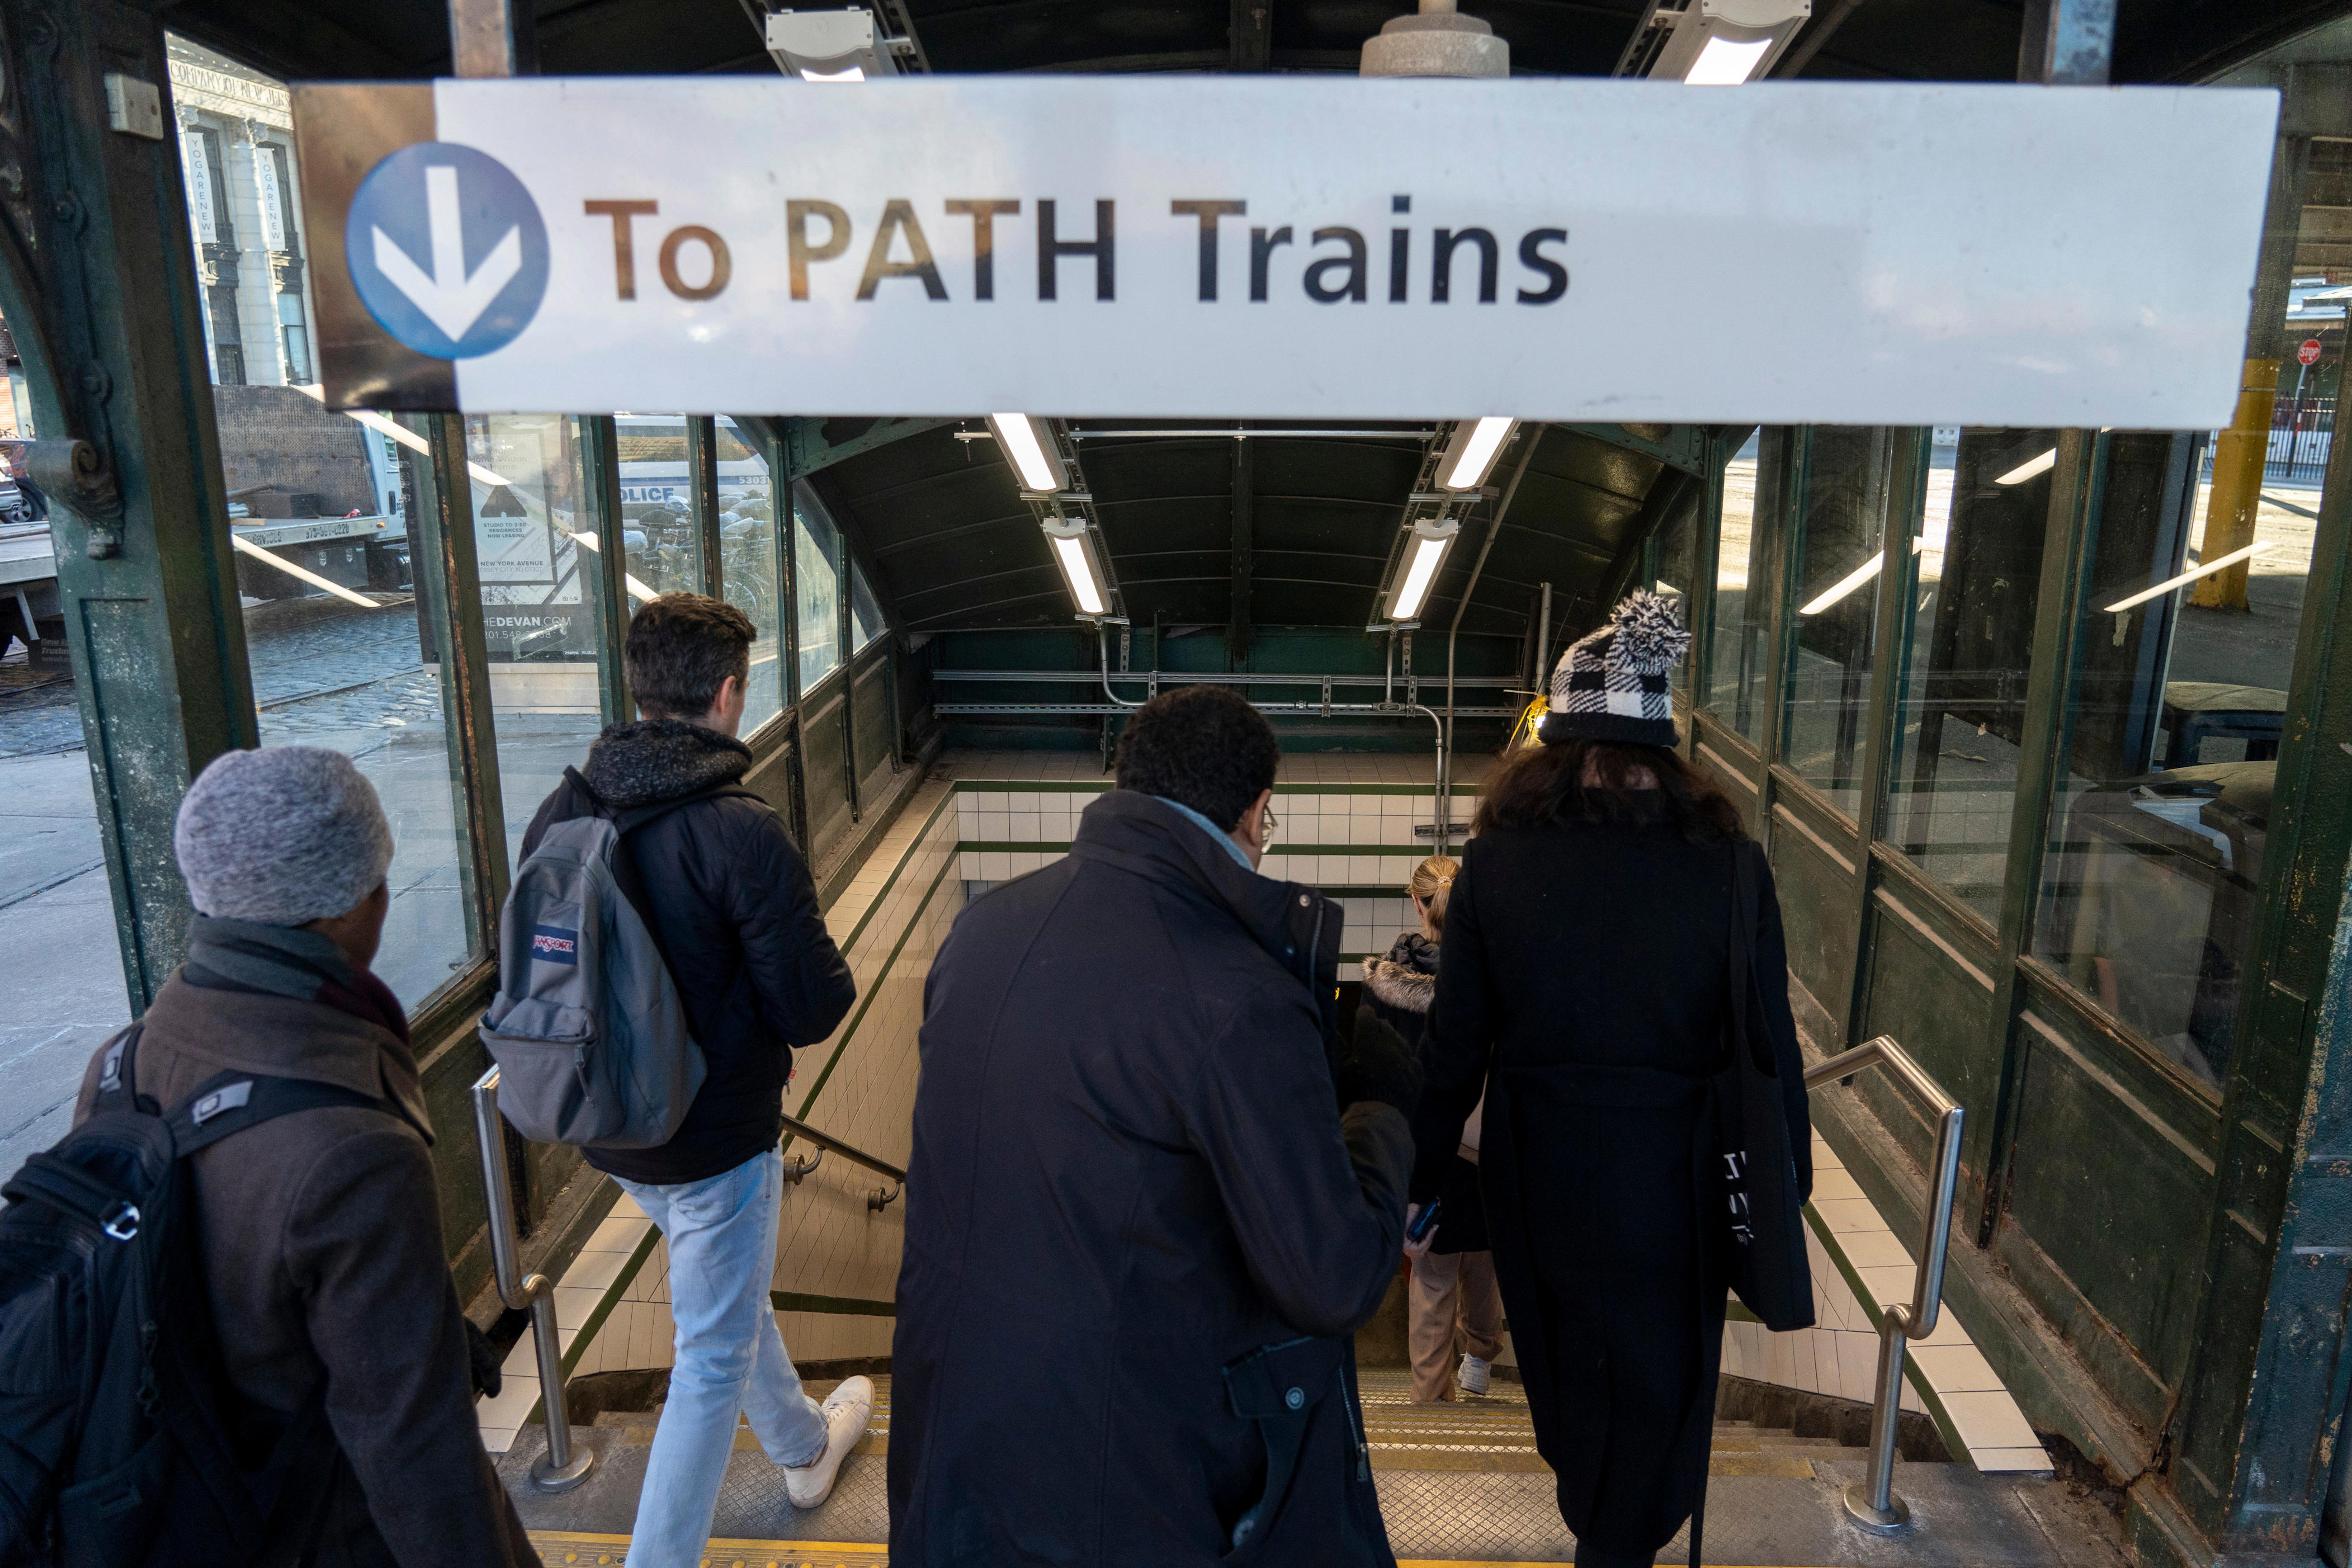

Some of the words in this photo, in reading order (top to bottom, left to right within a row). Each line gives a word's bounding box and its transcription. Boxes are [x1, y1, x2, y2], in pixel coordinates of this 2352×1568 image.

[171, 62, 221, 91] COMPANY
[225, 77, 239, 95] OF
[242, 82, 262, 101] NEW
[192, 140, 211, 230] YOGARENEW
[262, 154, 280, 239] YOGARENEW
[582, 199, 732, 302] To
[785, 198, 1116, 302] PATH
[1170, 194, 1570, 305] Trains
[2299, 347, 2319, 357] STOP
